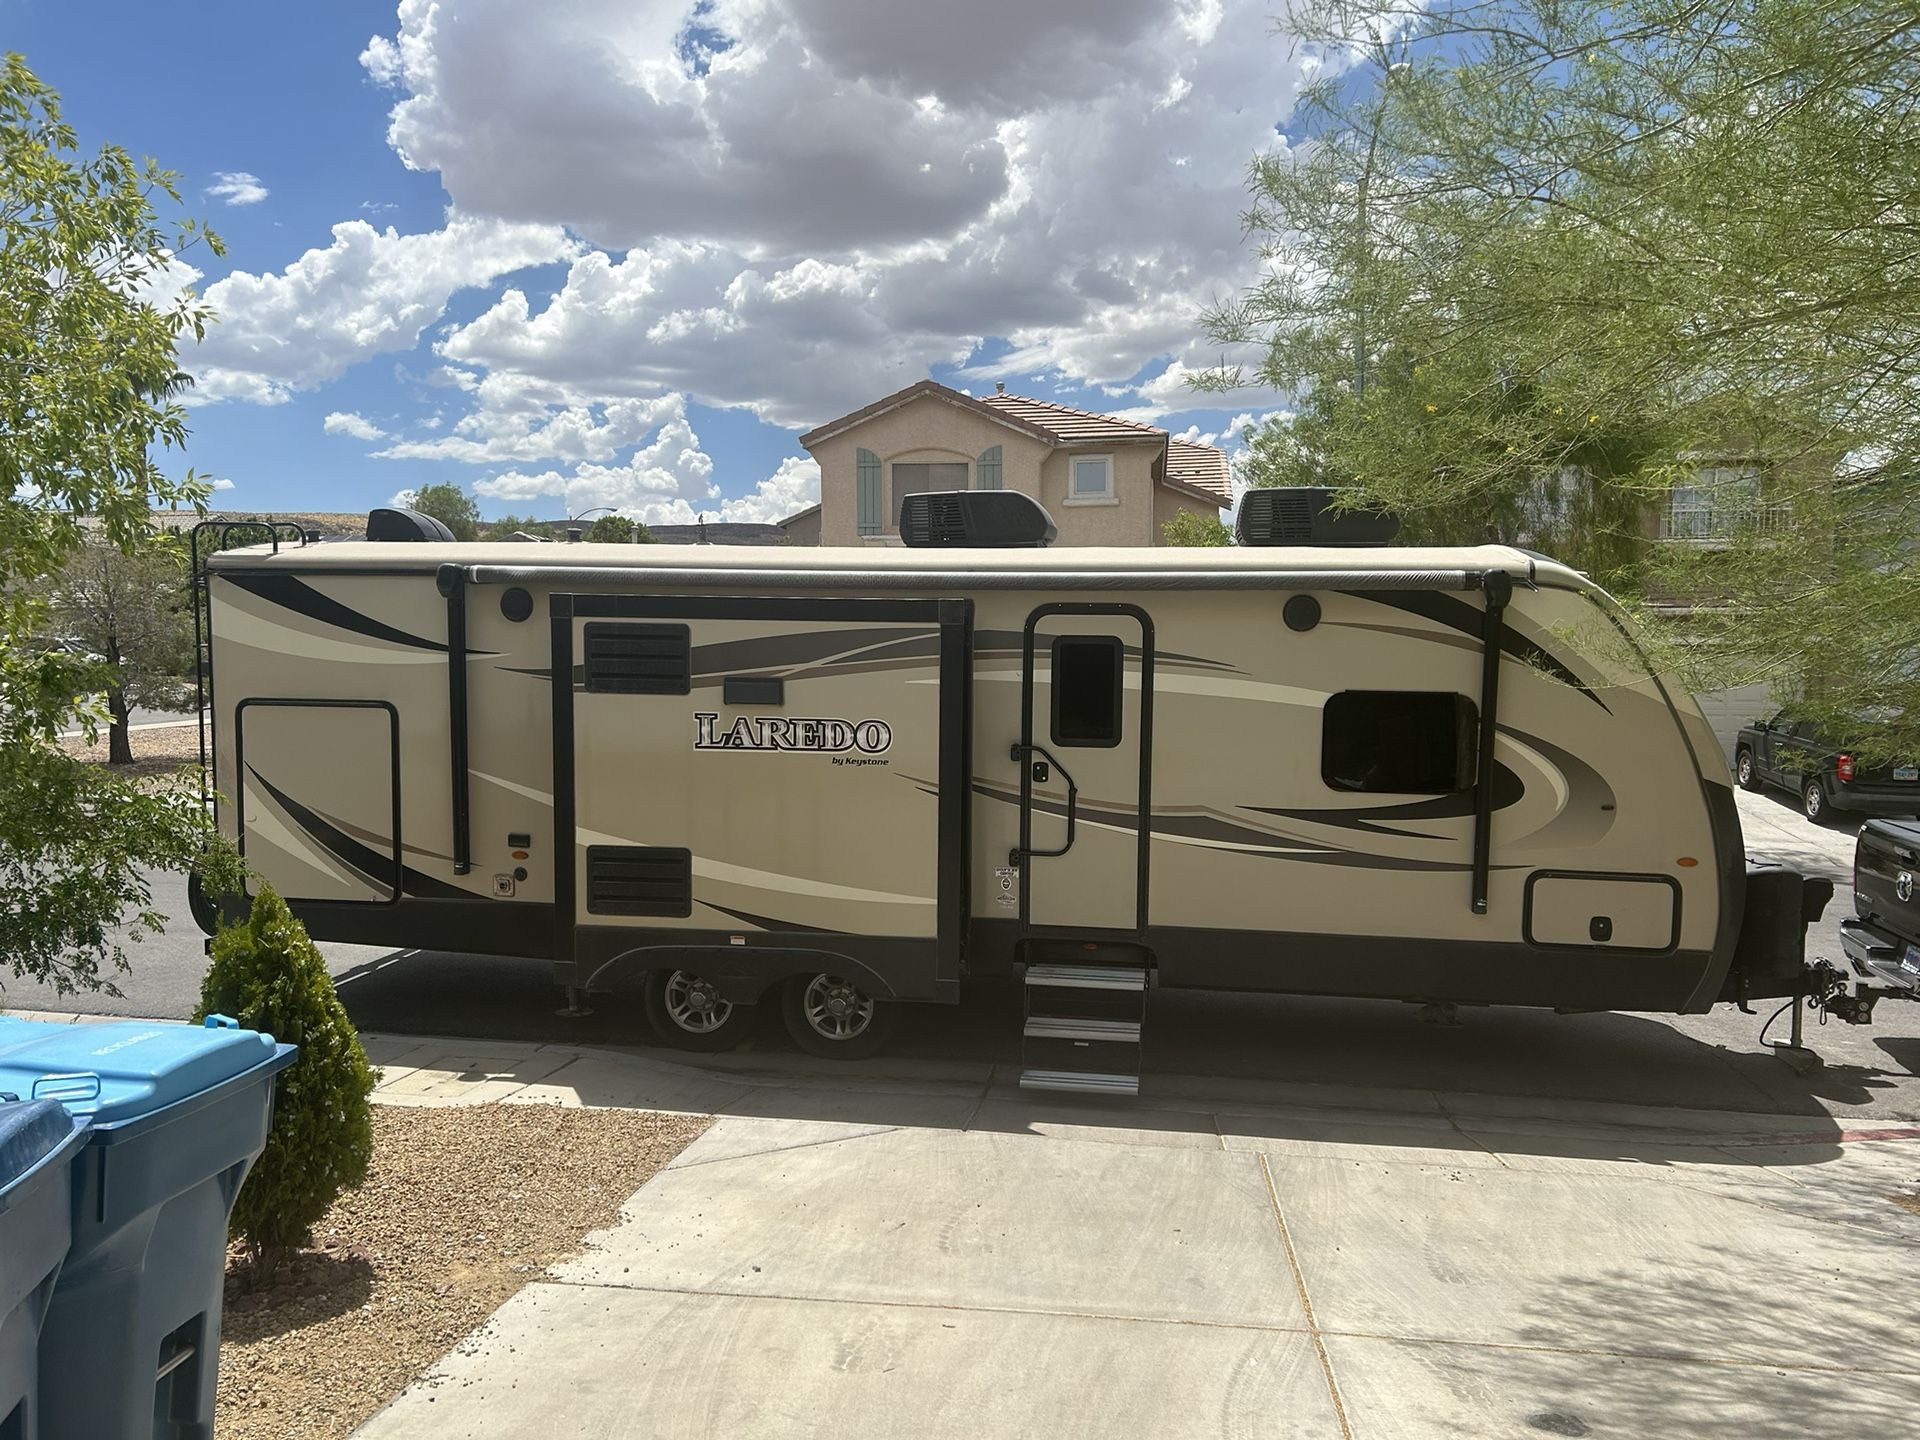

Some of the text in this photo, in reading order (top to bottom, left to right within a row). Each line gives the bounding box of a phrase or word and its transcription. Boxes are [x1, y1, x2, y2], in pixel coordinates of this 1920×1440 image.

[694, 712, 892, 754] LAREDO
[832, 757, 889, 766] by Keystone
